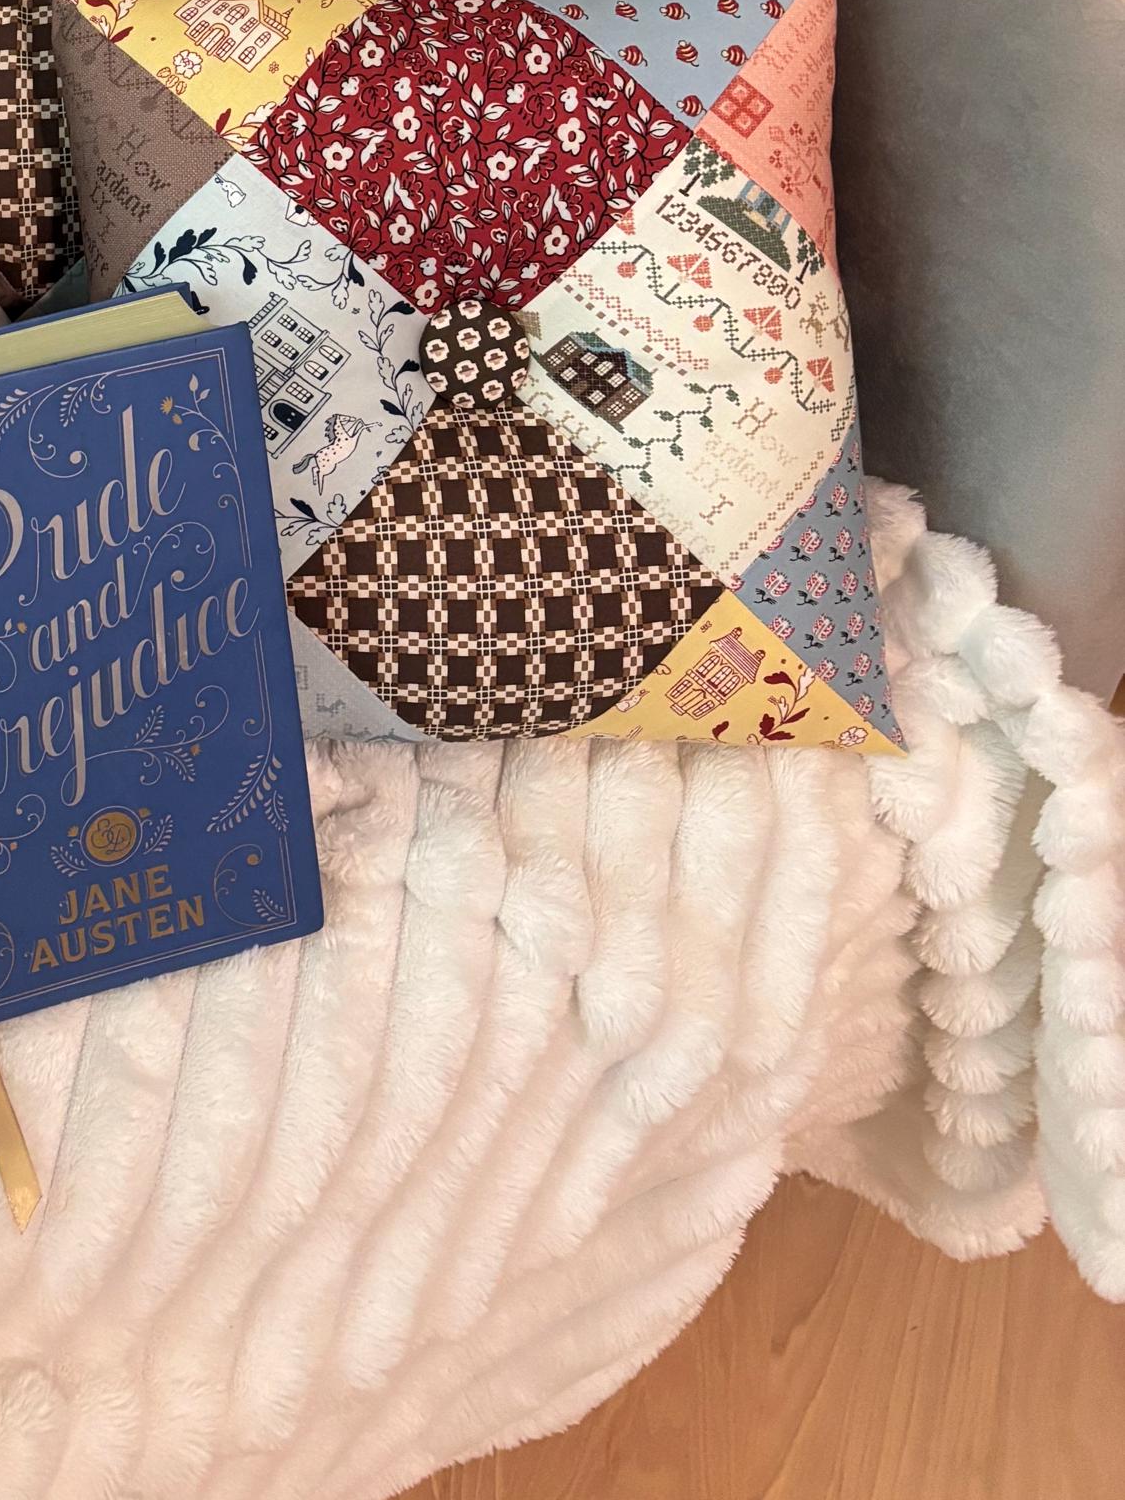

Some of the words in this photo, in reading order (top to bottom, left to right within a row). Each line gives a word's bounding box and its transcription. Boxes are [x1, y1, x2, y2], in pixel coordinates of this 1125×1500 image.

[654, 192, 803, 312] 1234567890
[27, 540, 165, 673] and
[29, 894, 206, 975] AUSTEN
[58, 862, 175, 927] JANE
